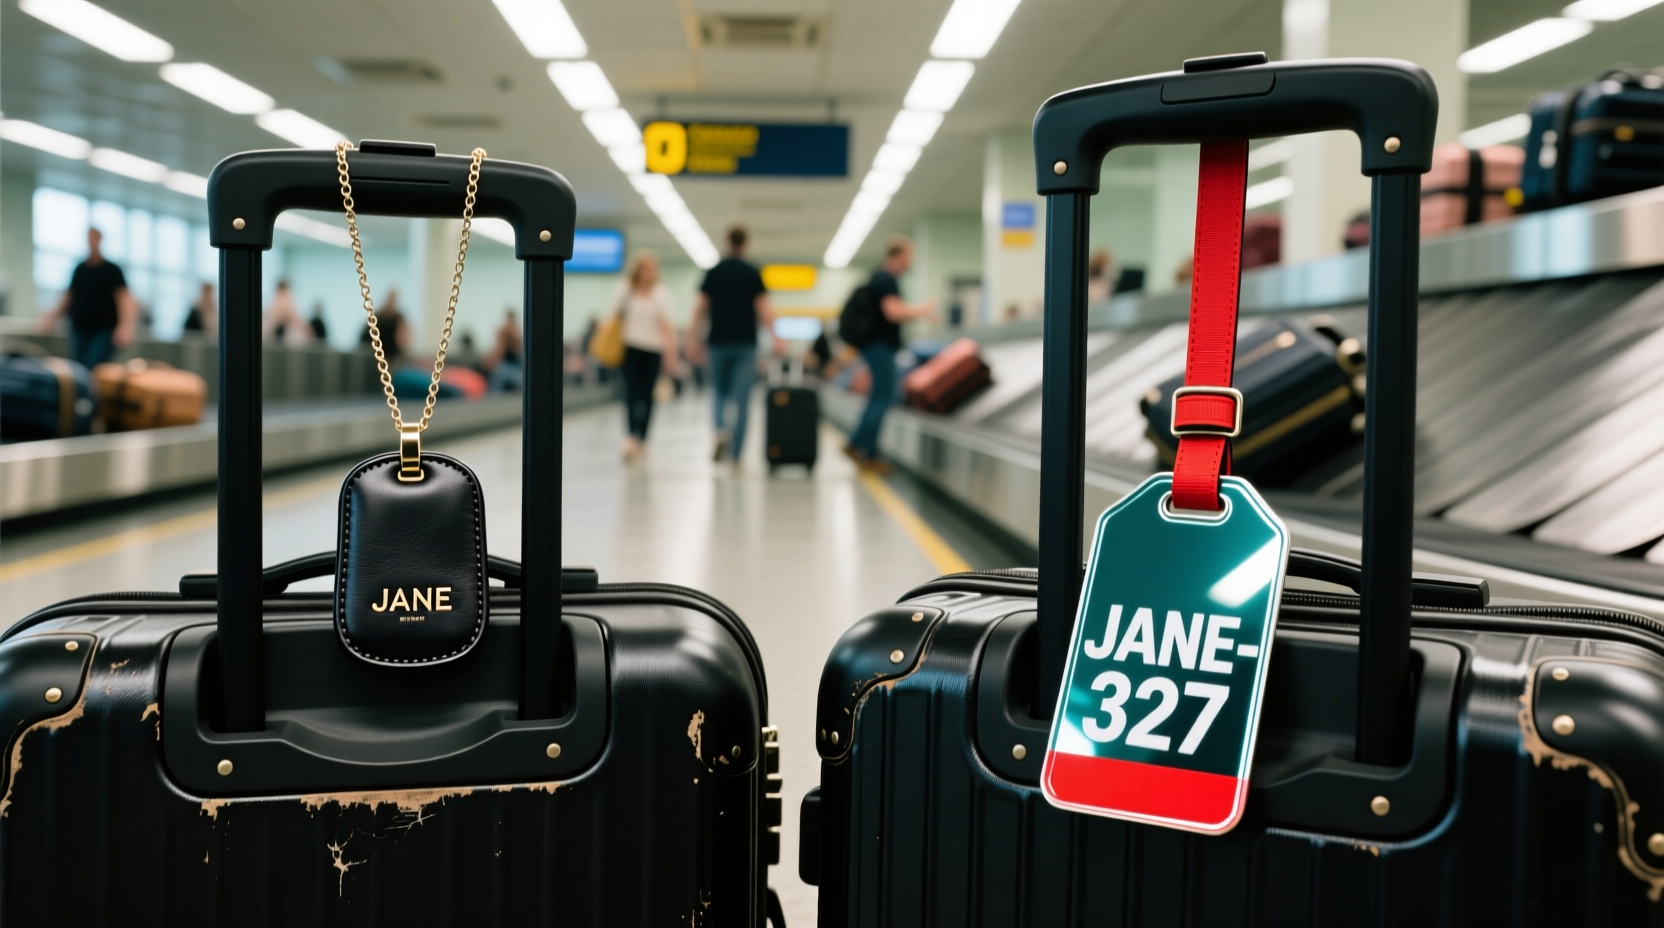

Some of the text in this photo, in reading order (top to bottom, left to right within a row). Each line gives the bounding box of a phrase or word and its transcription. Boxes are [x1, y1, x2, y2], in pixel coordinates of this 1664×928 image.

[371, 586, 453, 613] JANE
[1083, 604, 1259, 674] JANE-
[1081, 670, 1230, 755] 327
